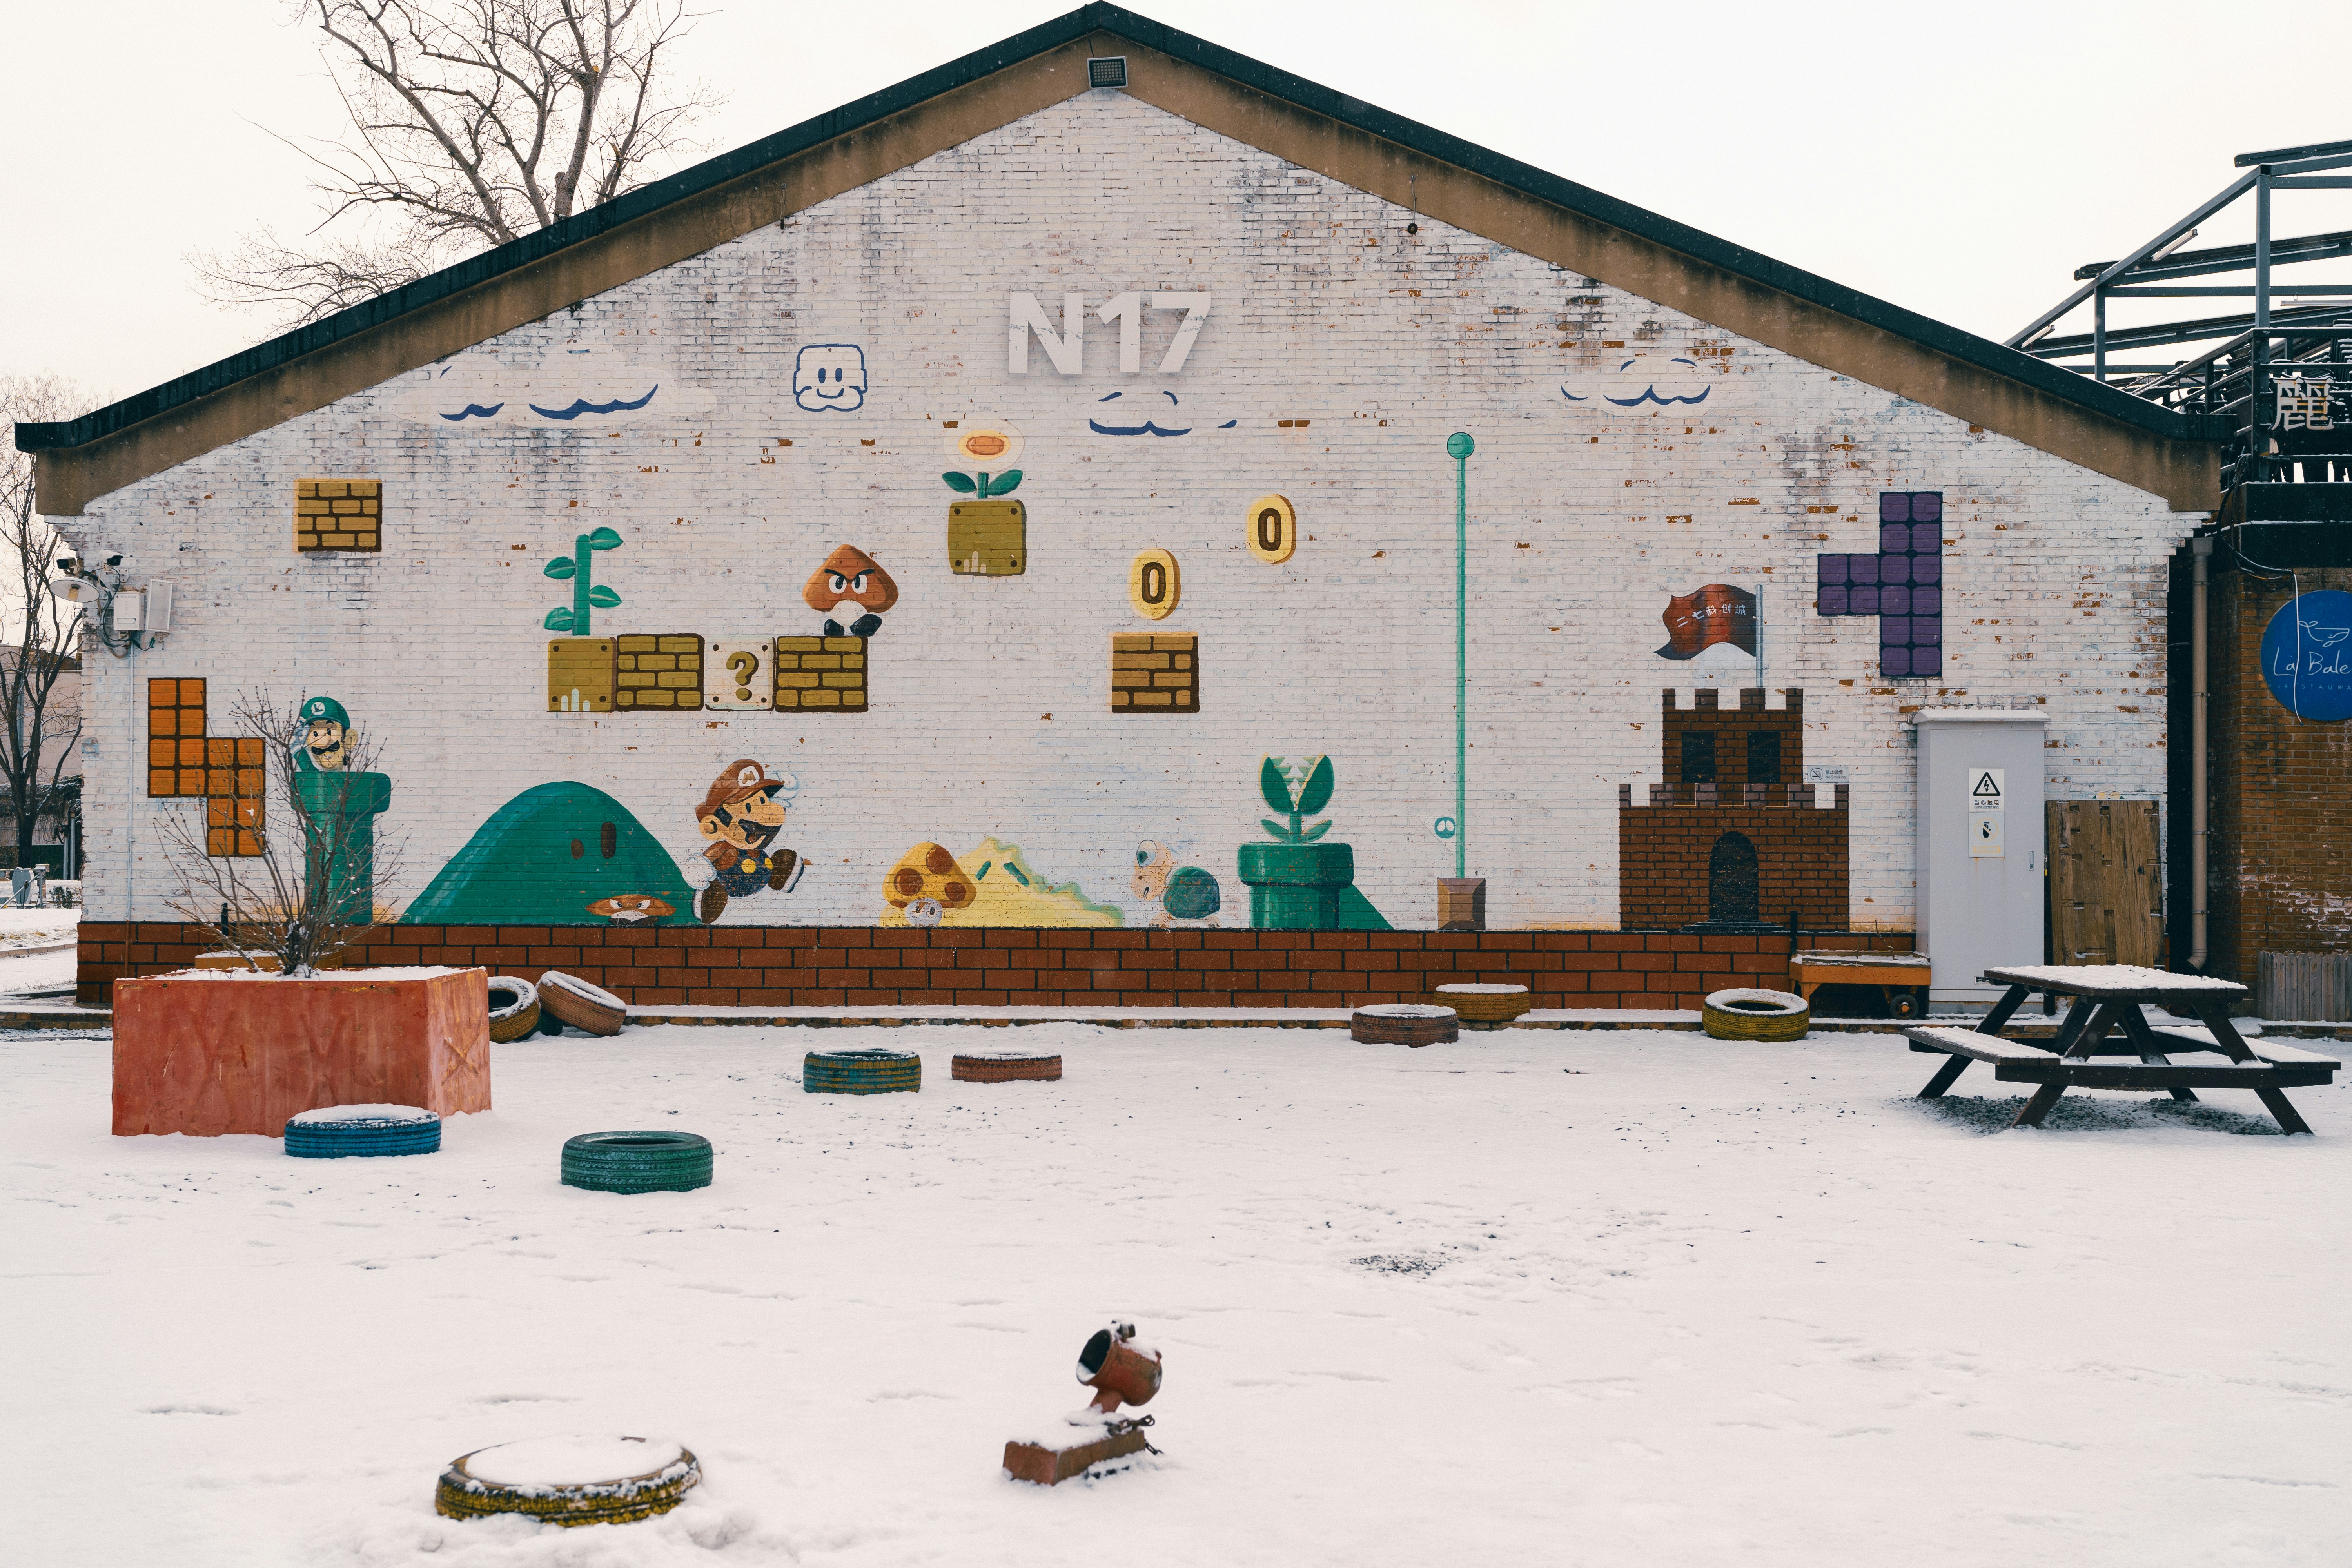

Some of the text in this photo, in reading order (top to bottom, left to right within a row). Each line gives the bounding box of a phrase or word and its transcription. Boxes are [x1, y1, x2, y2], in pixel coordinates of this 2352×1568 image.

[1009, 292, 1211, 374] N17
[2271, 376, 2335, 432] 麗
[1677, 603, 1746, 627] 二七科创城
[2273, 646, 2352, 676] La Bale
[742, 771, 756, 785] M
